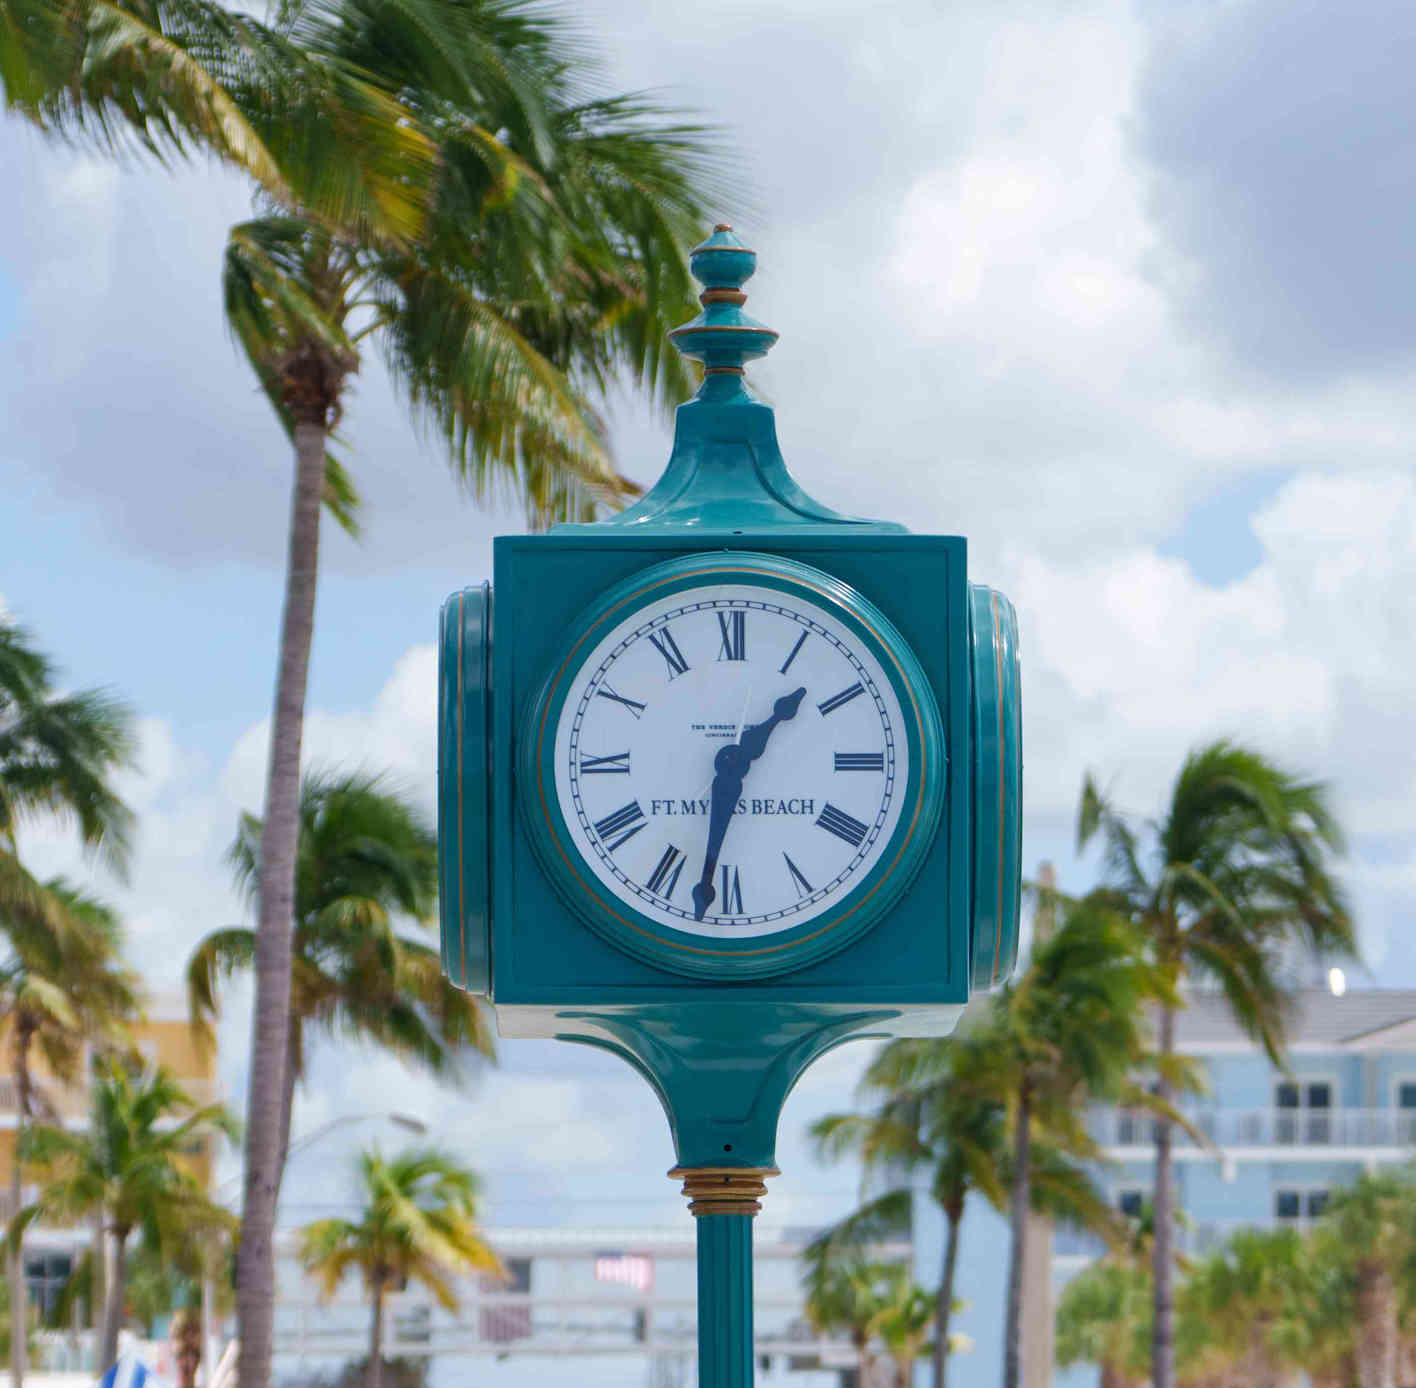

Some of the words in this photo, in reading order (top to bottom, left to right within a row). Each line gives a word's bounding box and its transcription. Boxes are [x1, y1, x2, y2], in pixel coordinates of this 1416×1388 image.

[648, 627, 691, 681] XI
[716, 610, 747, 661] XII
[779, 629, 812, 676] I
[596, 681, 647, 719] X
[817, 681, 868, 717] II
[580, 751, 631, 777] IX
[834, 751, 884, 773] III
[592, 799, 649, 853] VIII
[651, 799, 677, 816] FT.
[680, 799, 748, 816] MYS
[751, 798, 815, 815] BEACH
[645, 844, 688, 900] VII
[720, 864, 745, 915] VI
[783, 851, 815, 900] V
